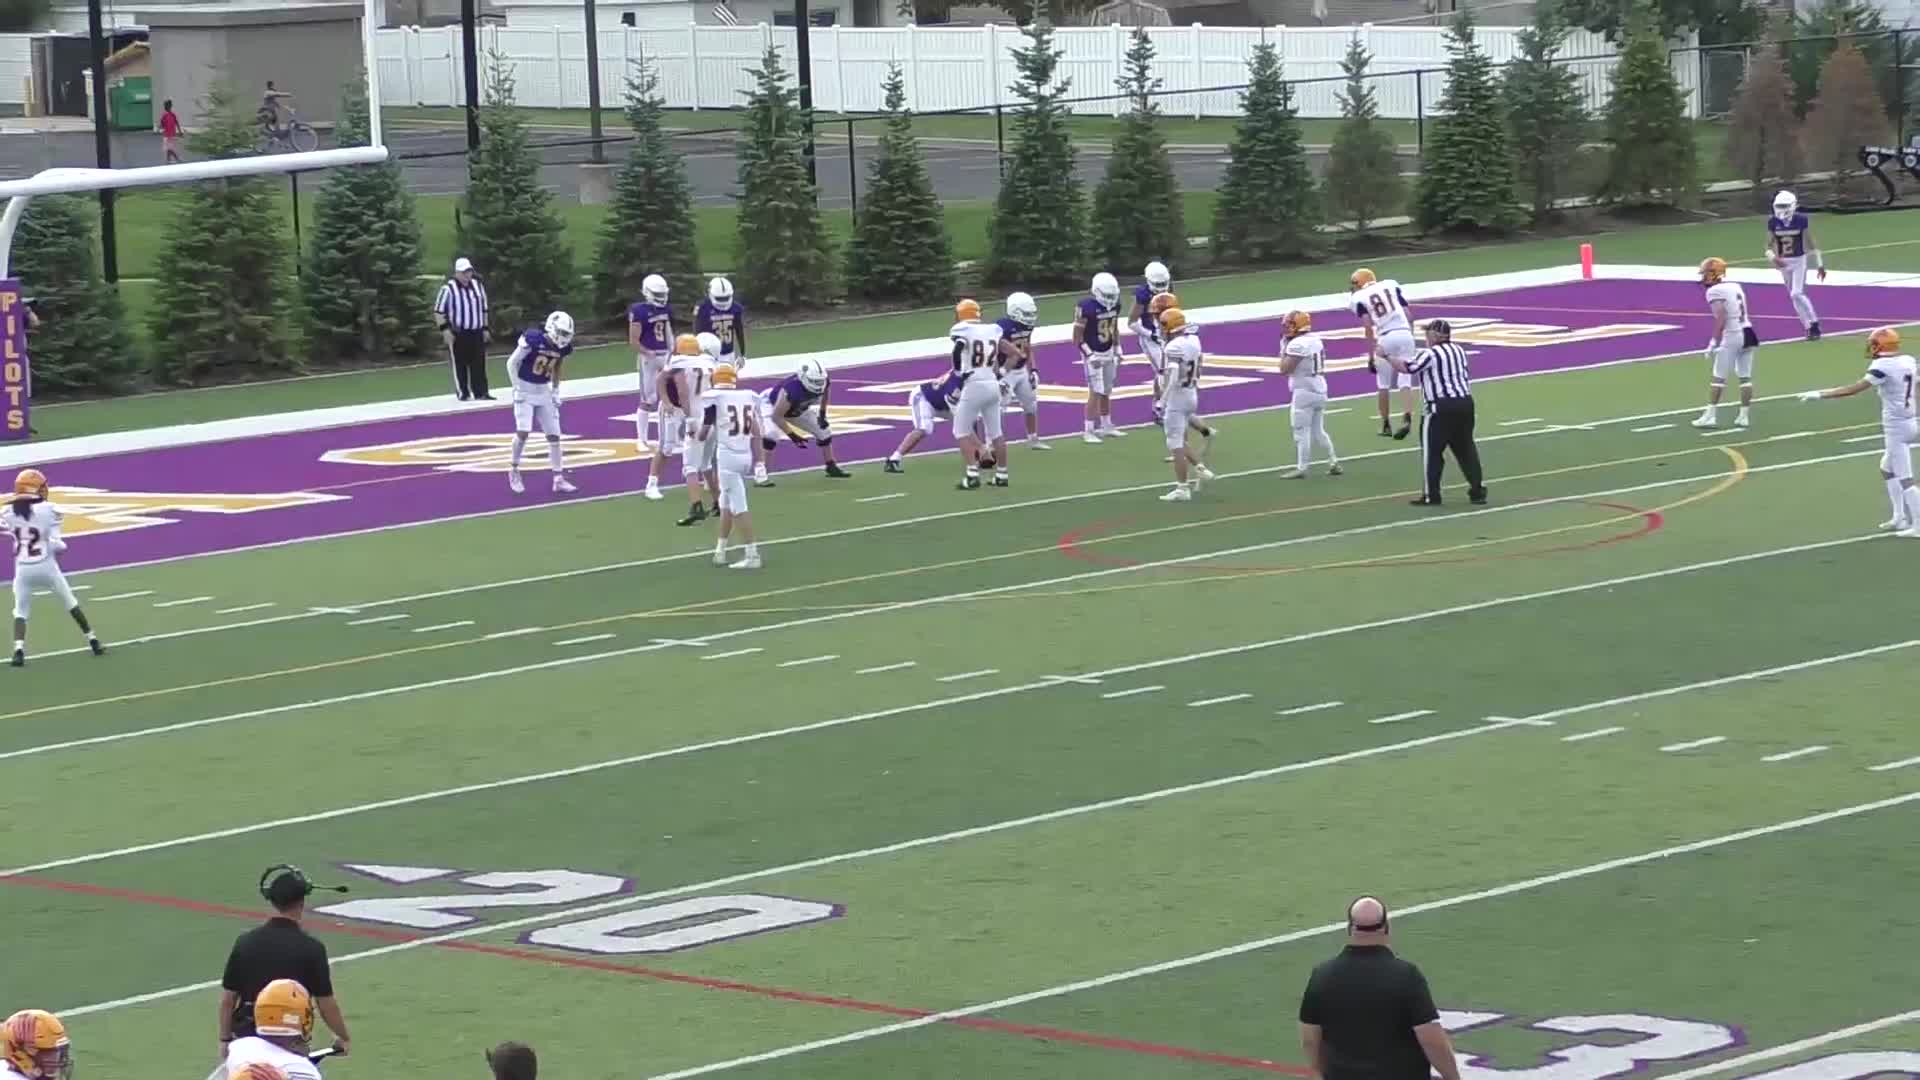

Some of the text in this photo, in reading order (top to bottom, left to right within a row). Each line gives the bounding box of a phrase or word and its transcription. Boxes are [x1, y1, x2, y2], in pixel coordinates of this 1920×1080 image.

[1369, 288, 1396, 318] 81
[1, 292, 24, 430] PILOTS
[971, 339, 997, 367] 82
[727, 404, 752, 436] 36
[311, 869, 846, 954] 20
